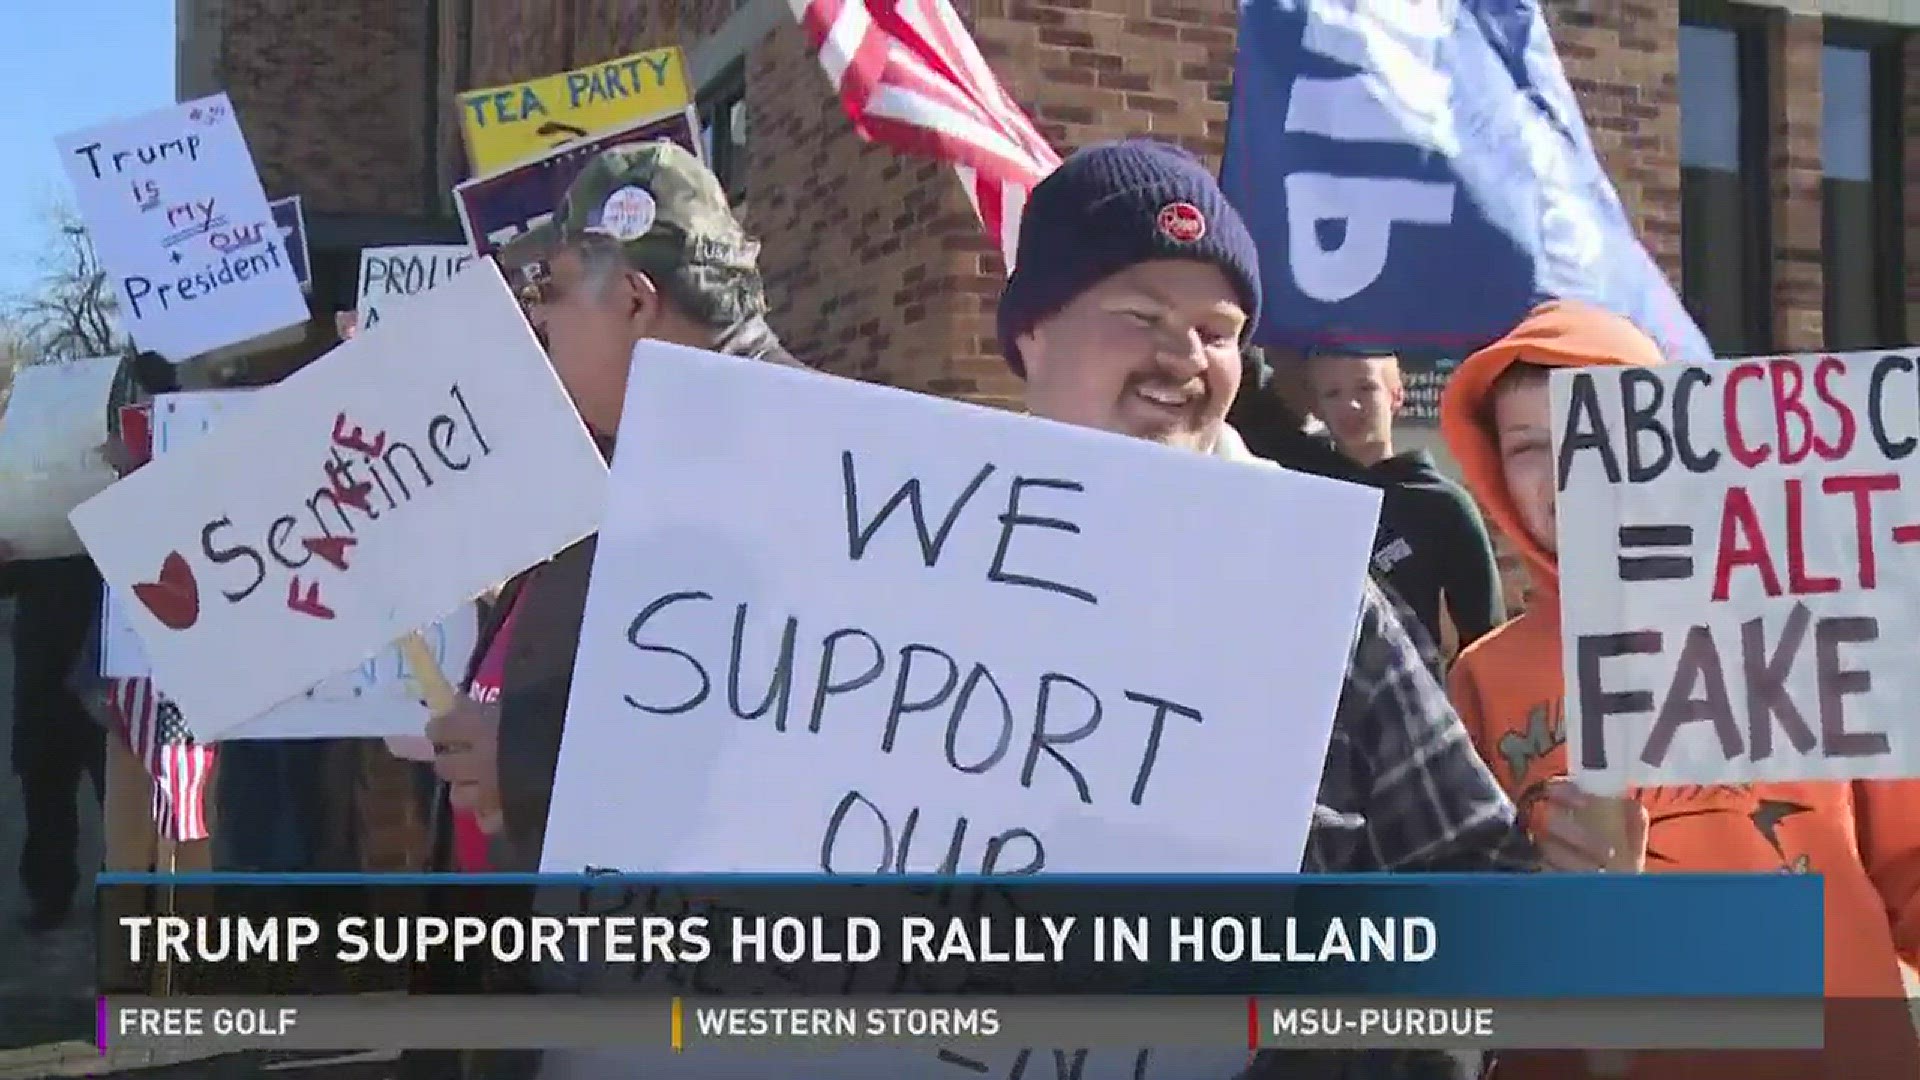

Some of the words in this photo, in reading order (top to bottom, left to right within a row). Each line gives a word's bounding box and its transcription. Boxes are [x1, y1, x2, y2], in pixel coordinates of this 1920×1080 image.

[466, 86, 547, 128] TEA
[566, 52, 671, 108] PARTY
[75, 133, 201, 179] Trump
[130, 179, 160, 204] is
[166, 197, 215, 233] my
[208, 221, 266, 252] our
[124, 241, 281, 320] President
[1557, 367, 1721, 491] ABC
[1723, 356, 1856, 469] CBS
[842, 450, 1098, 605] WE
[623, 591, 1204, 806] SUPPORT
[1576, 601, 1892, 770] FAKE
